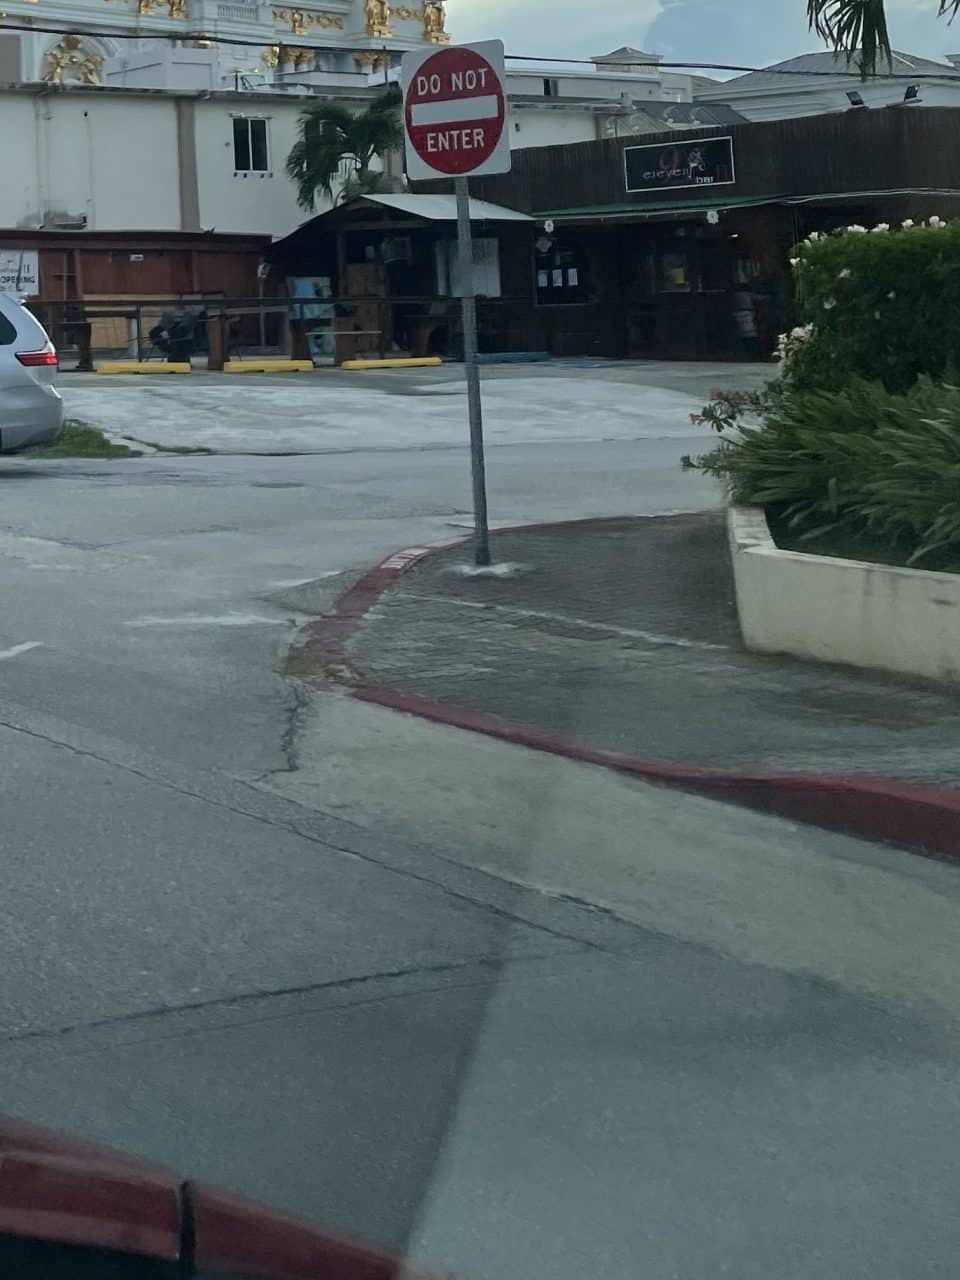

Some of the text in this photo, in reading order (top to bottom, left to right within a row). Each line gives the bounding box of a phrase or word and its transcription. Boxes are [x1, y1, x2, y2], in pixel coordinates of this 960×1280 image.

[417, 68, 488, 96] DO NOT
[427, 128, 485, 152] ENTER
